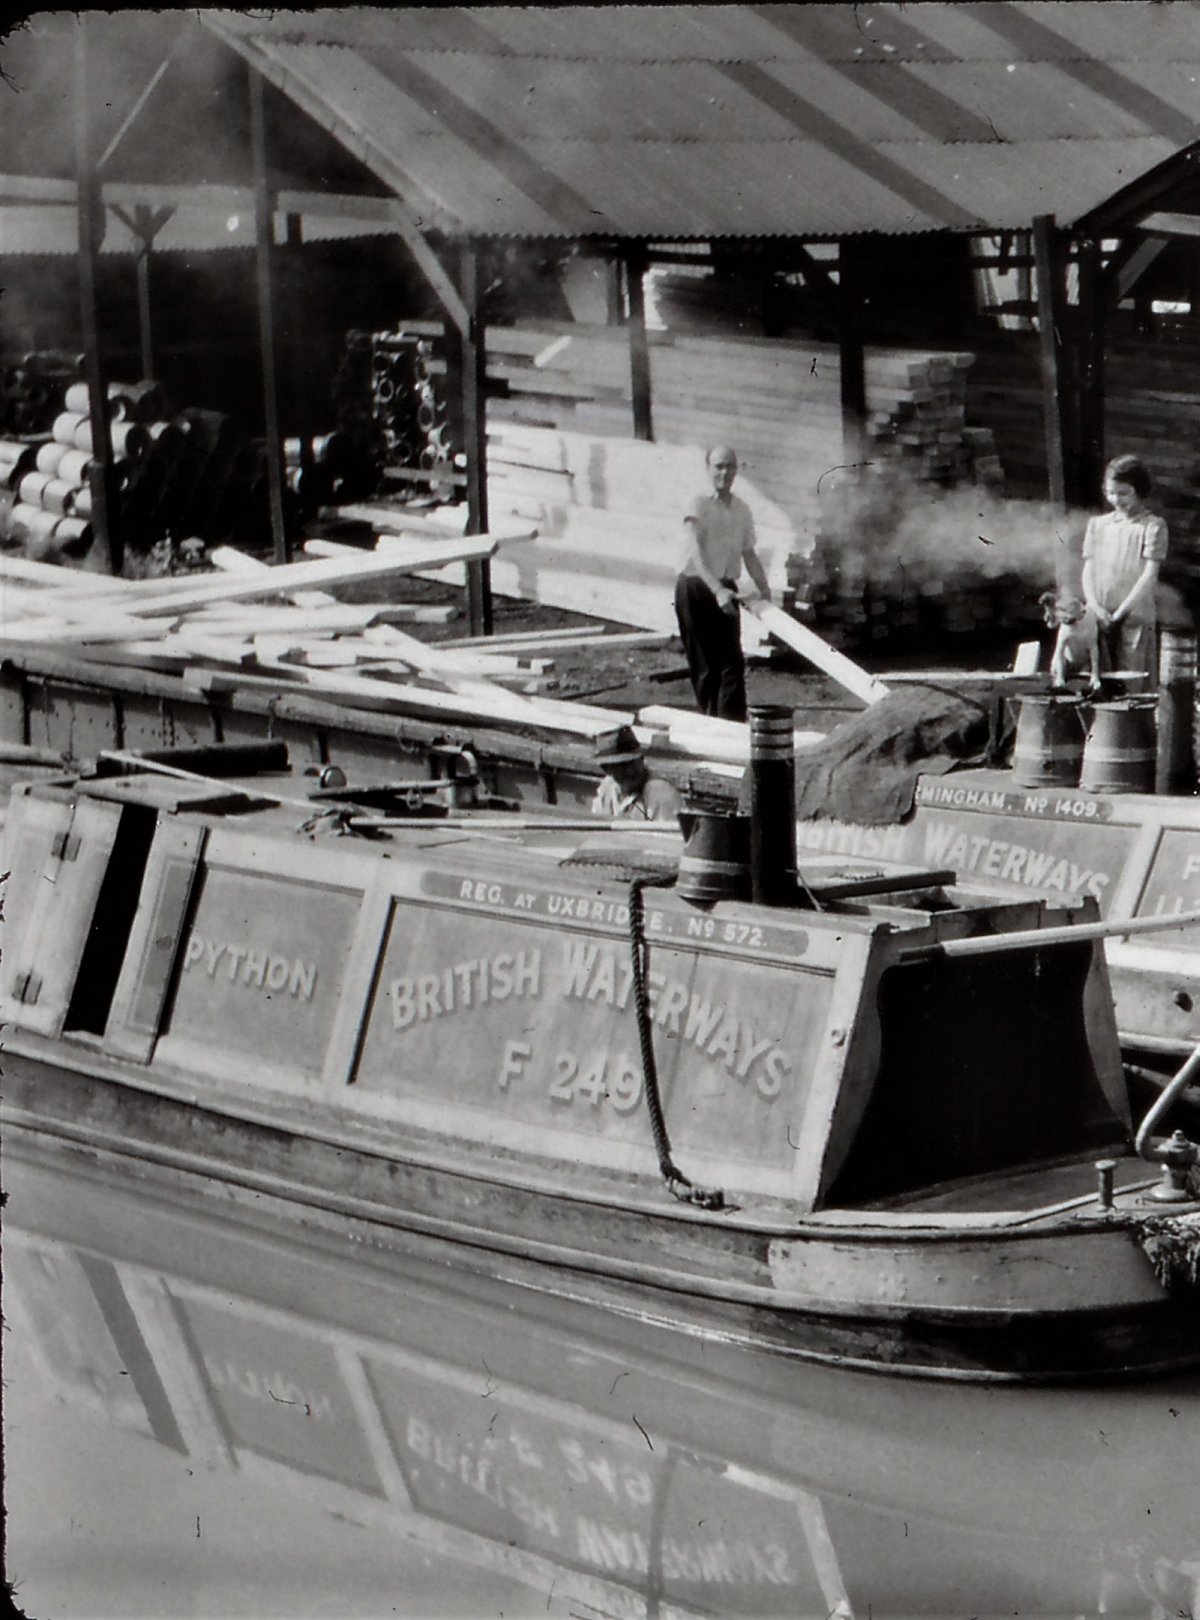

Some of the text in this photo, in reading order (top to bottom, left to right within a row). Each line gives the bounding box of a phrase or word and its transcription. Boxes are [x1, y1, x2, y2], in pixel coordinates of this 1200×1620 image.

[925, 822, 1110, 896] WATERWAYS
[514, 892, 536, 910] AT
[548, 899, 672, 933] UXBRIDE.
[184, 938, 318, 1000] PYTHON
[390, 940, 792, 1098] BRITISH WATERWAYS
[499, 1039, 645, 1117] F 249
